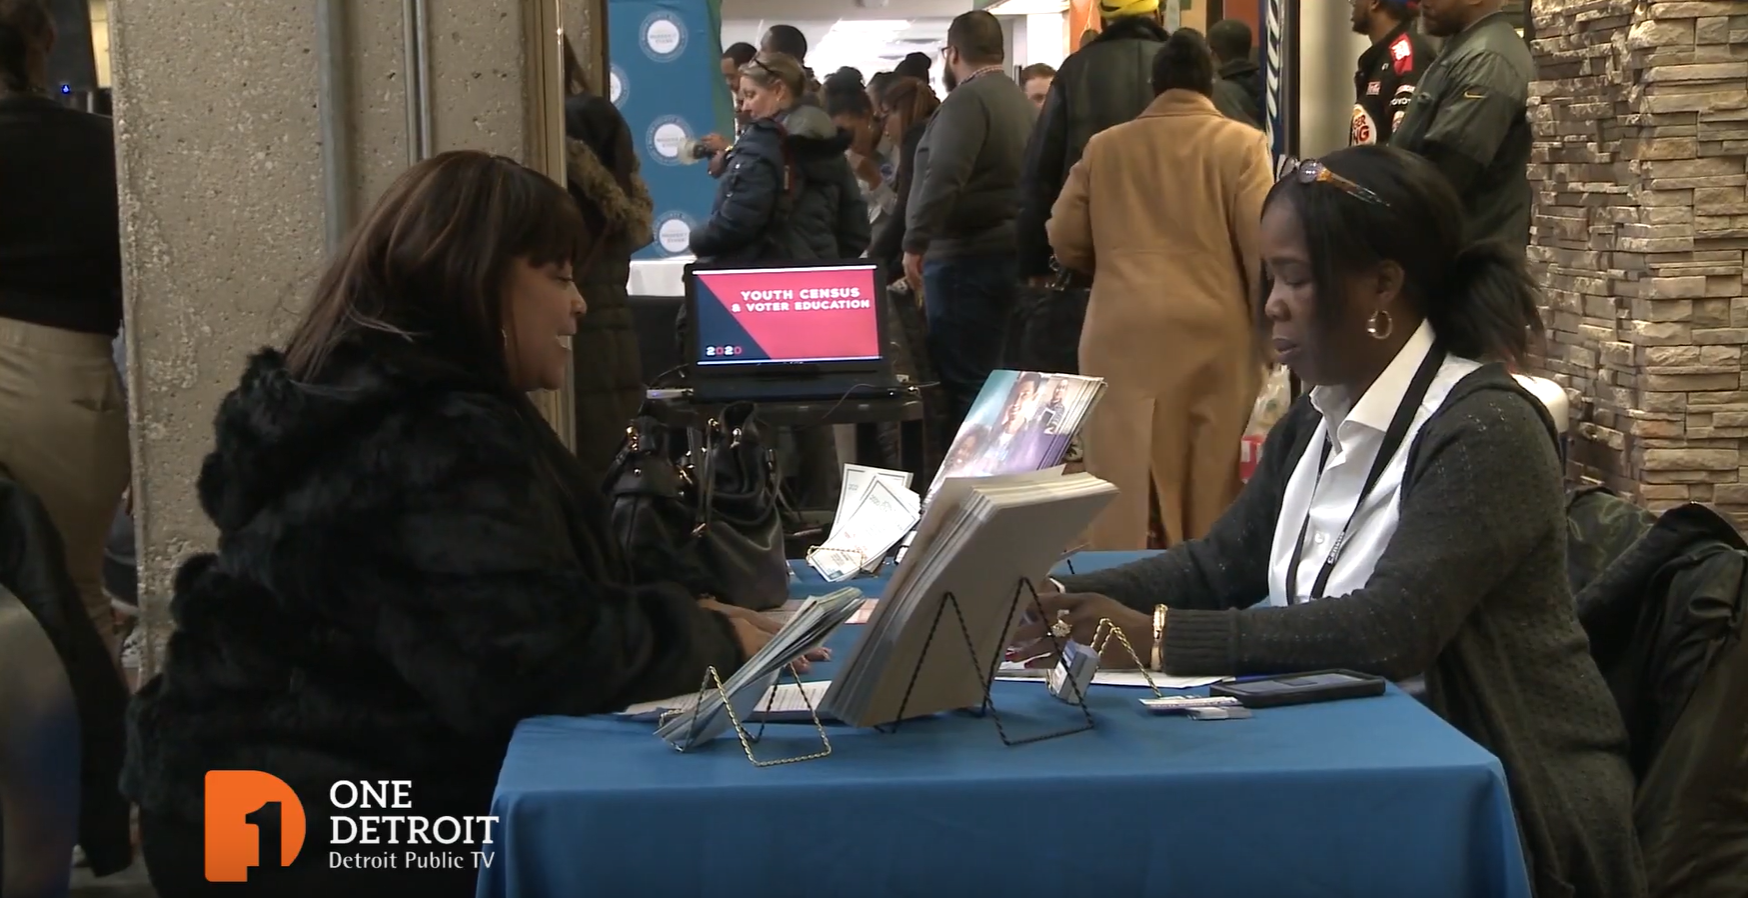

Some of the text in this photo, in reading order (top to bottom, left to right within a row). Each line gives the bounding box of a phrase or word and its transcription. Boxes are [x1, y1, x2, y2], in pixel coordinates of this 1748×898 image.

[741, 287, 861, 301] YOUTH CENSUS
[731, 299, 870, 312] & VOTER EDUCATION
[706, 345, 742, 356] 2020
